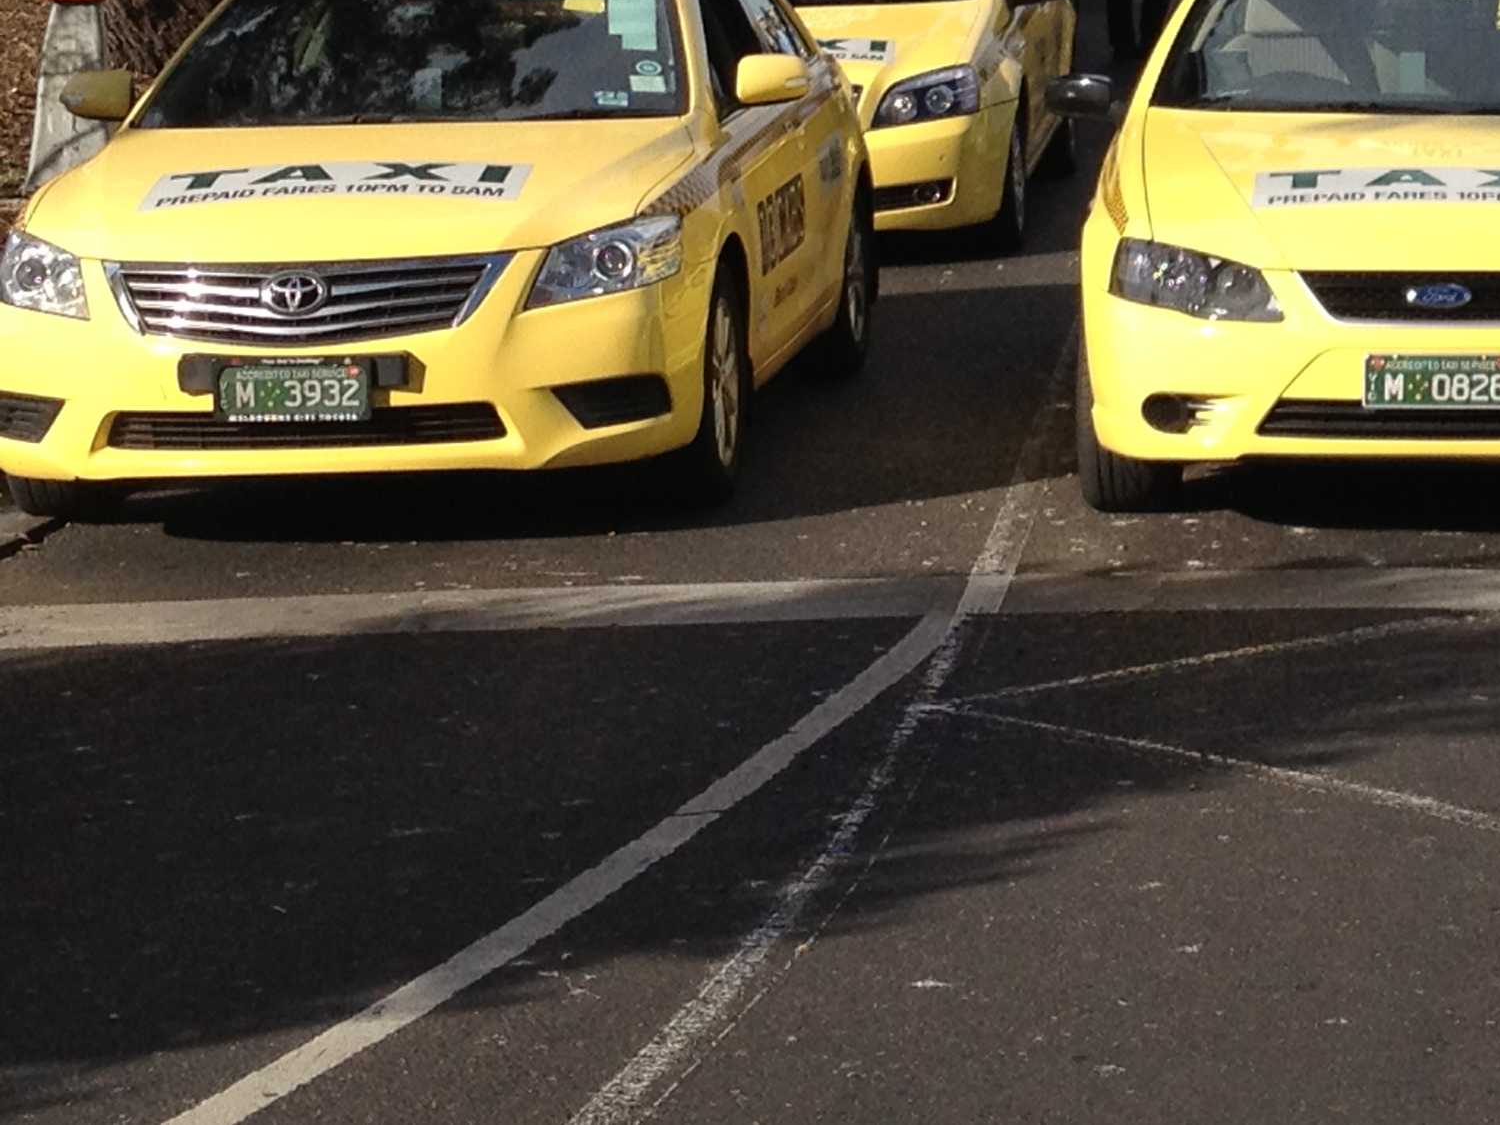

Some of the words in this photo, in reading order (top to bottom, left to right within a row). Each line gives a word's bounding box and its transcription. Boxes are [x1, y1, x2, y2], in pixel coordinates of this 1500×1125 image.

[170, 162, 514, 192] TAXI
[155, 187, 257, 208] PREPAID
[262, 183, 337, 197] FARES
[345, 183, 411, 195] 10PM
[417, 184, 446, 195] TO
[451, 186, 506, 198] 5AM
[1267, 191, 1366, 206] PREPAID
[1374, 190, 1448, 201] FARES
[235, 380, 256, 409] M
[283, 379, 360, 407] 3932
[1384, 373, 1405, 401] M
